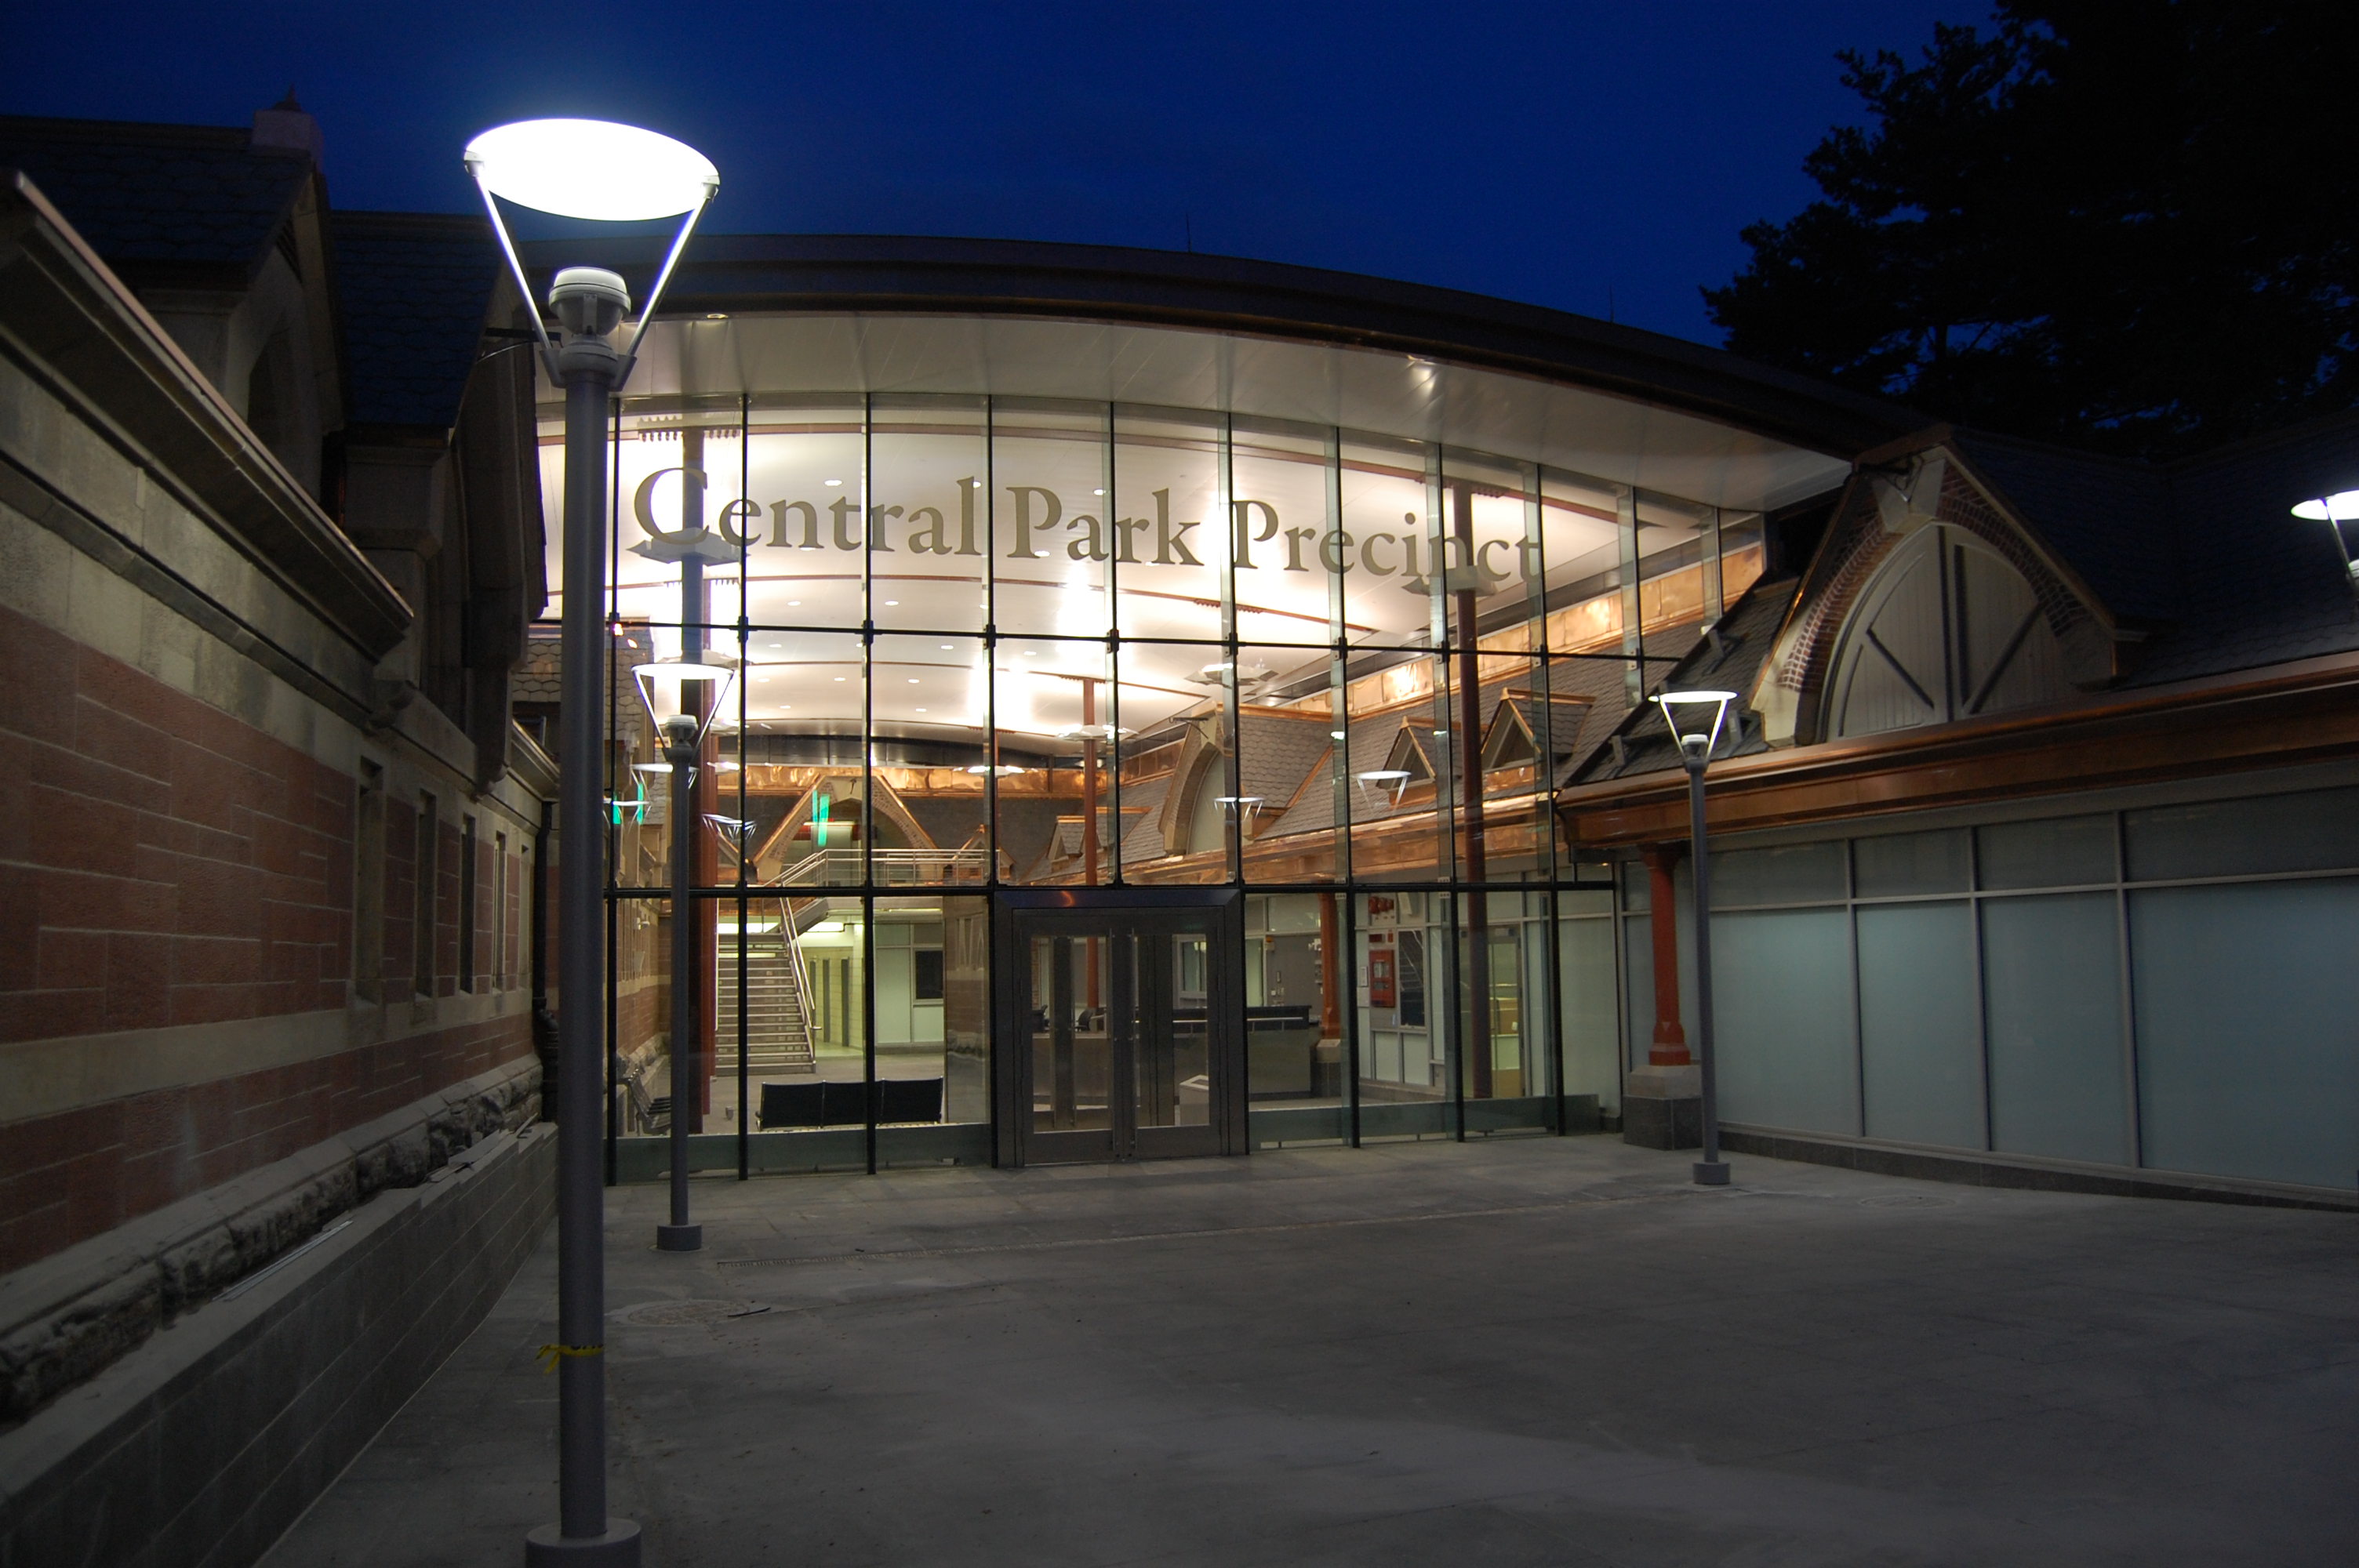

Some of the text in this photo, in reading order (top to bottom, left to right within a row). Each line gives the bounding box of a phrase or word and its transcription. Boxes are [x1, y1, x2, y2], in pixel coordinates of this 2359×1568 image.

[634, 466, 1543, 584] Central Park Precinct
